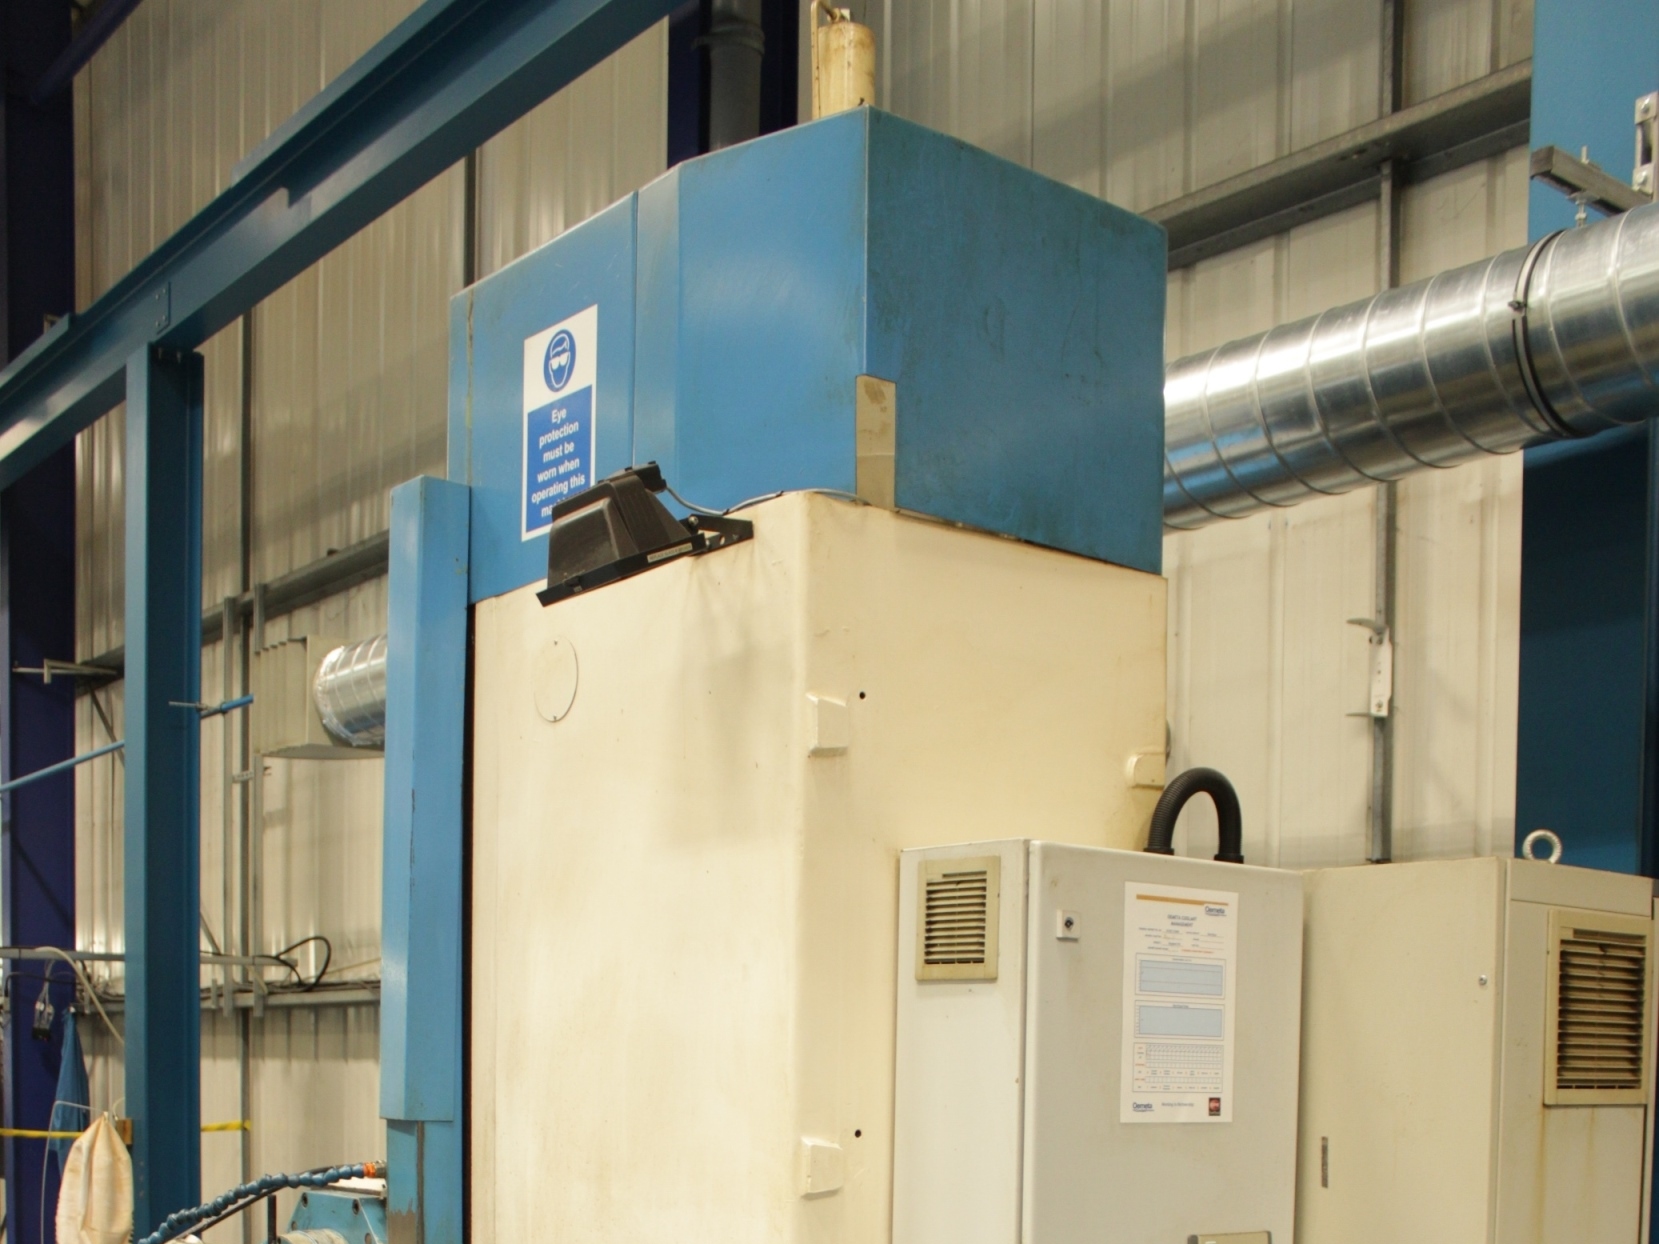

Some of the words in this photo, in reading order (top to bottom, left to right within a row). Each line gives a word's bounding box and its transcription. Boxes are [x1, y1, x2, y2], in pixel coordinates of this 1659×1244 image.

[551, 408, 567, 424] Eye
[539, 421, 579, 449] protection
[543, 445, 563, 463] must
[564, 441, 575, 455] be
[537, 466, 557, 483] worn
[558, 457, 580, 475] when
[531, 481, 569, 504] operating
[570, 473, 586, 489] this
